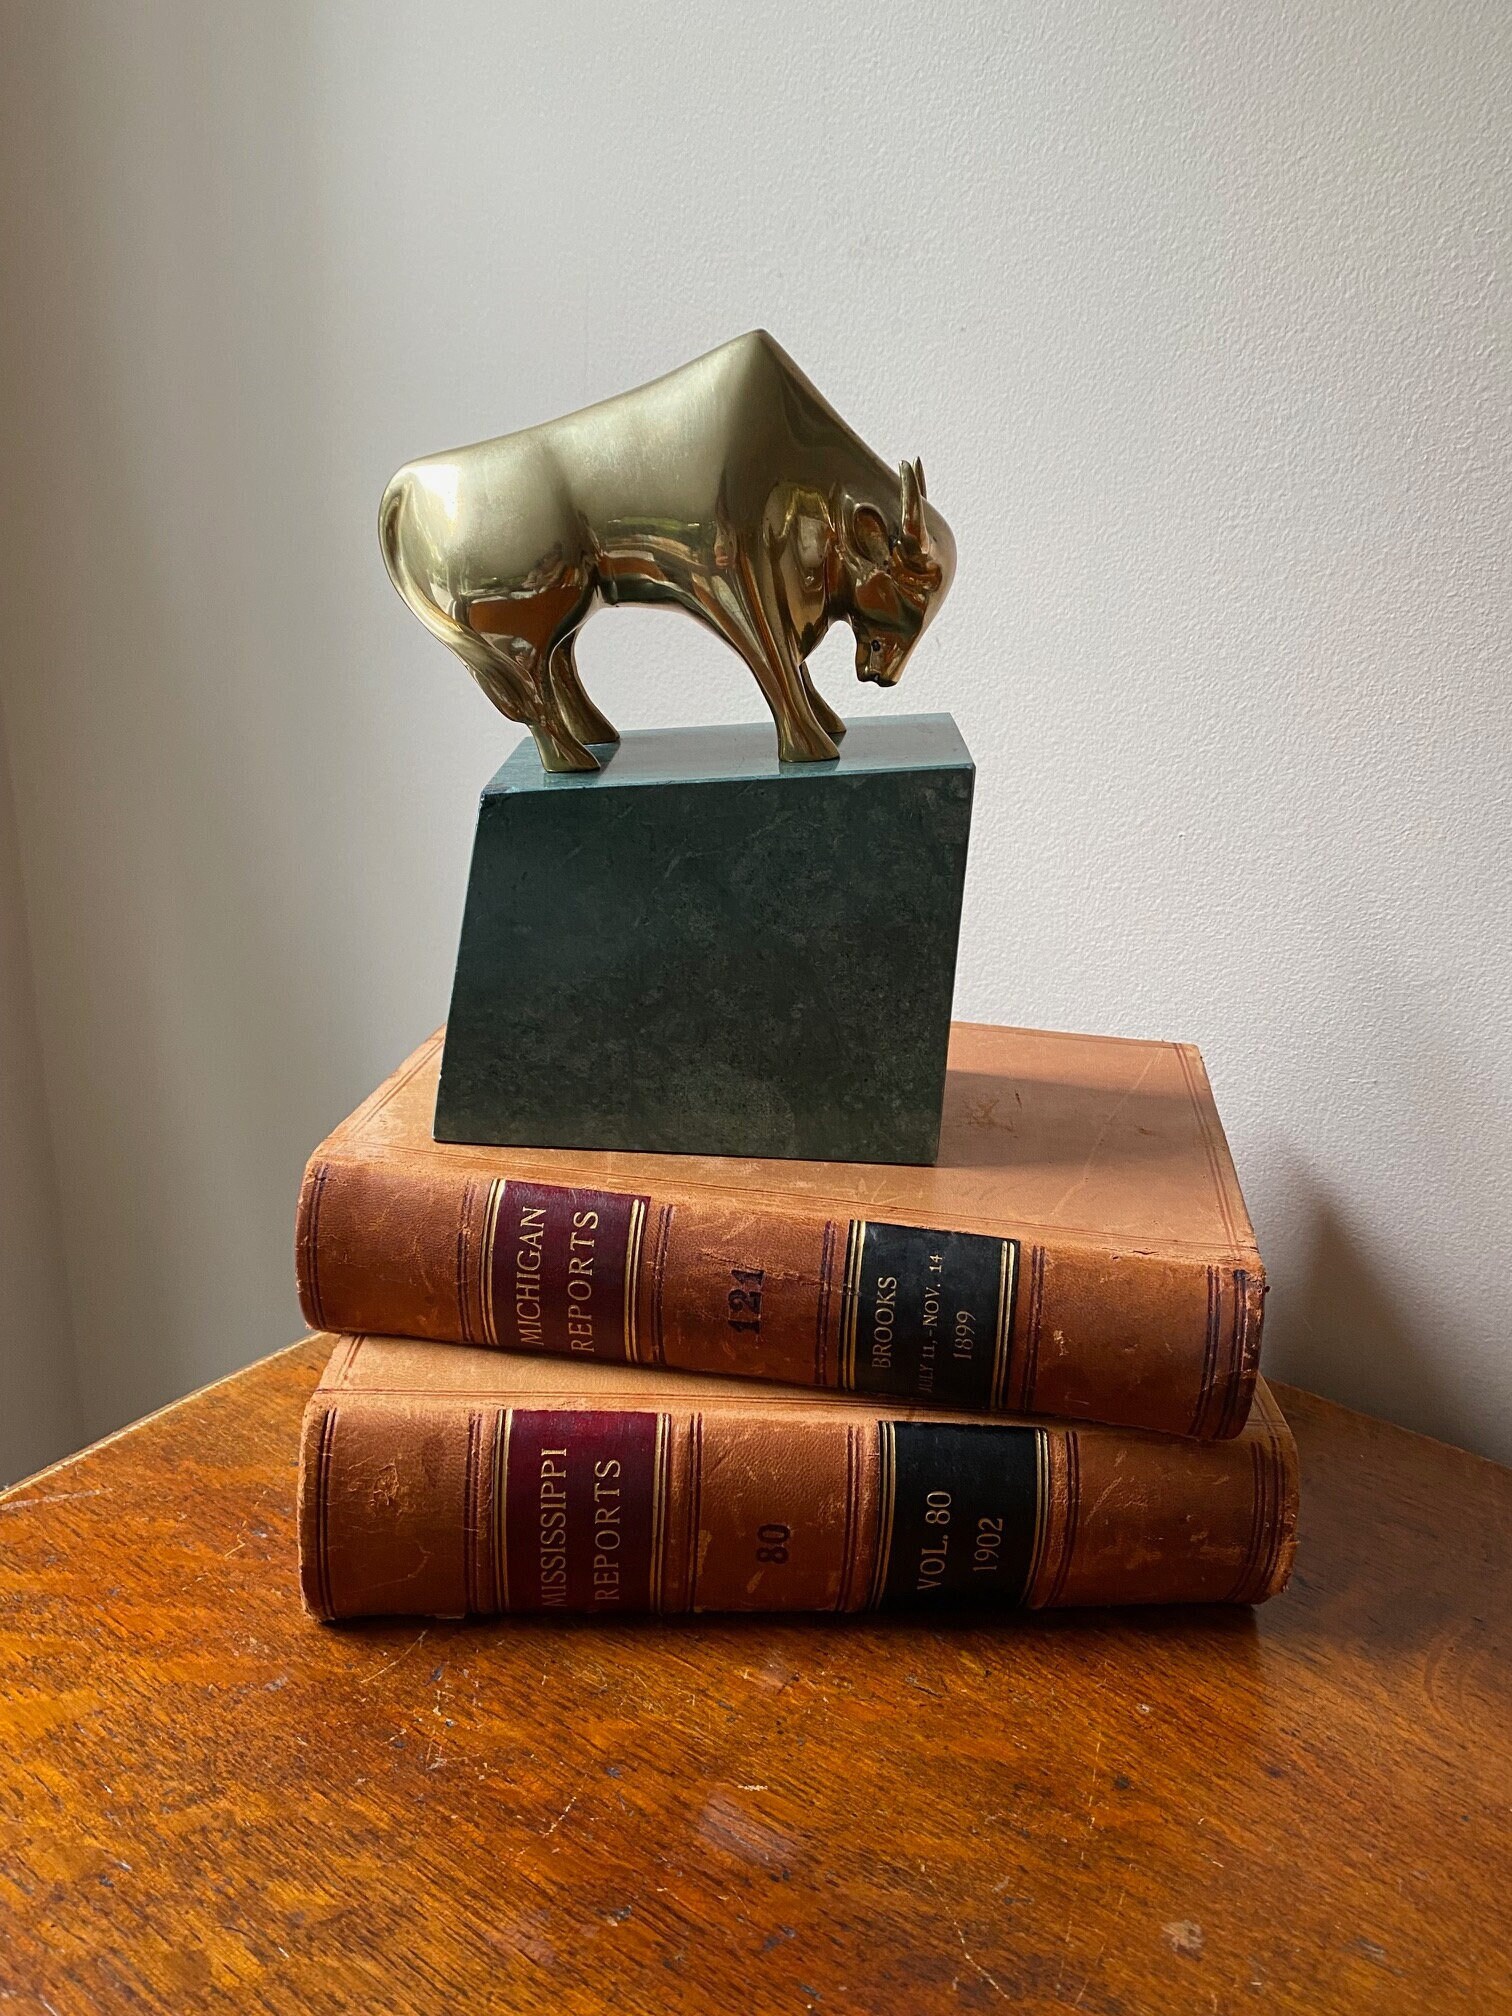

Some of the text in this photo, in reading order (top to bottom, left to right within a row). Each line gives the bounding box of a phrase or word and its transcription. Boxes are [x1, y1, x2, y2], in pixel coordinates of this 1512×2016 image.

[516, 1206, 547, 1346] MICHIGAN
[567, 1211, 599, 1352] REPORTS
[728, 1269, 765, 1334] 121
[871, 1276, 898, 1369] BROOKS
[918, 1363, 934, 1393] JULY
[929, 1253, 943, 1273] 14
[953, 1310, 977, 1360] 1899
[540, 1448, 568, 1607] MISSISSIPPI
[593, 1459, 621, 1600] REPORTS
[756, 1524, 791, 1565] 80
[917, 1490, 952, 1591] VOL. 80
[972, 1517, 1004, 1572] 1902
